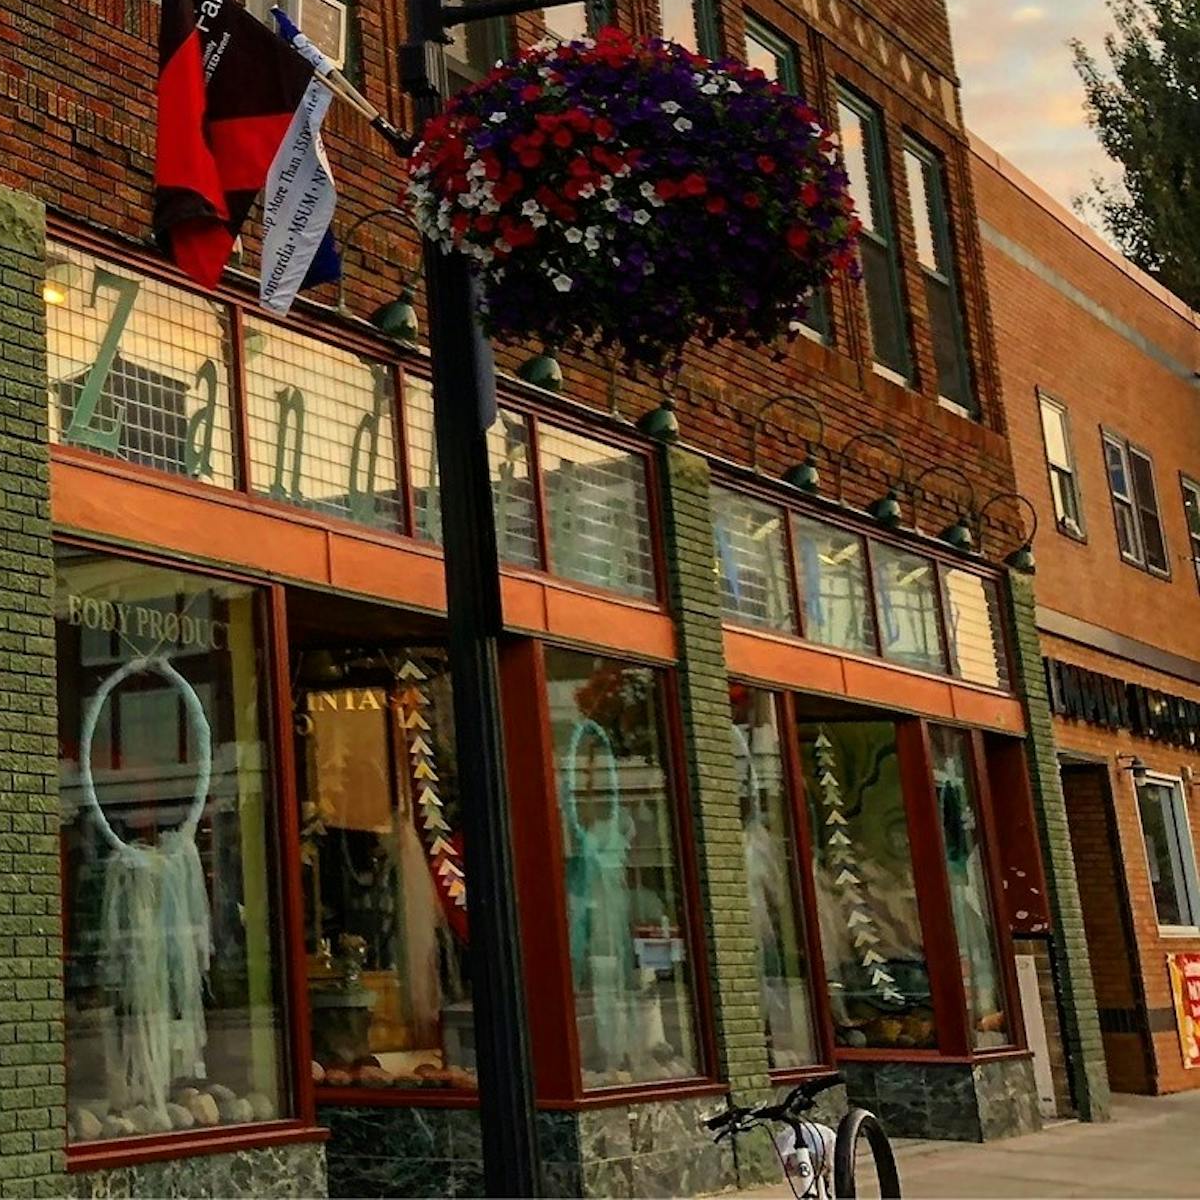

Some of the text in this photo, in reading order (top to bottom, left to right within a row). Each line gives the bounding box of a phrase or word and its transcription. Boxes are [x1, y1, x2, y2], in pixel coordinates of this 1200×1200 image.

[265, 186, 289, 216] More
[278, 155, 301, 184] Than
[287, 191, 319, 236] MSUM
[67, 594, 230, 650] BODY PRODUC
